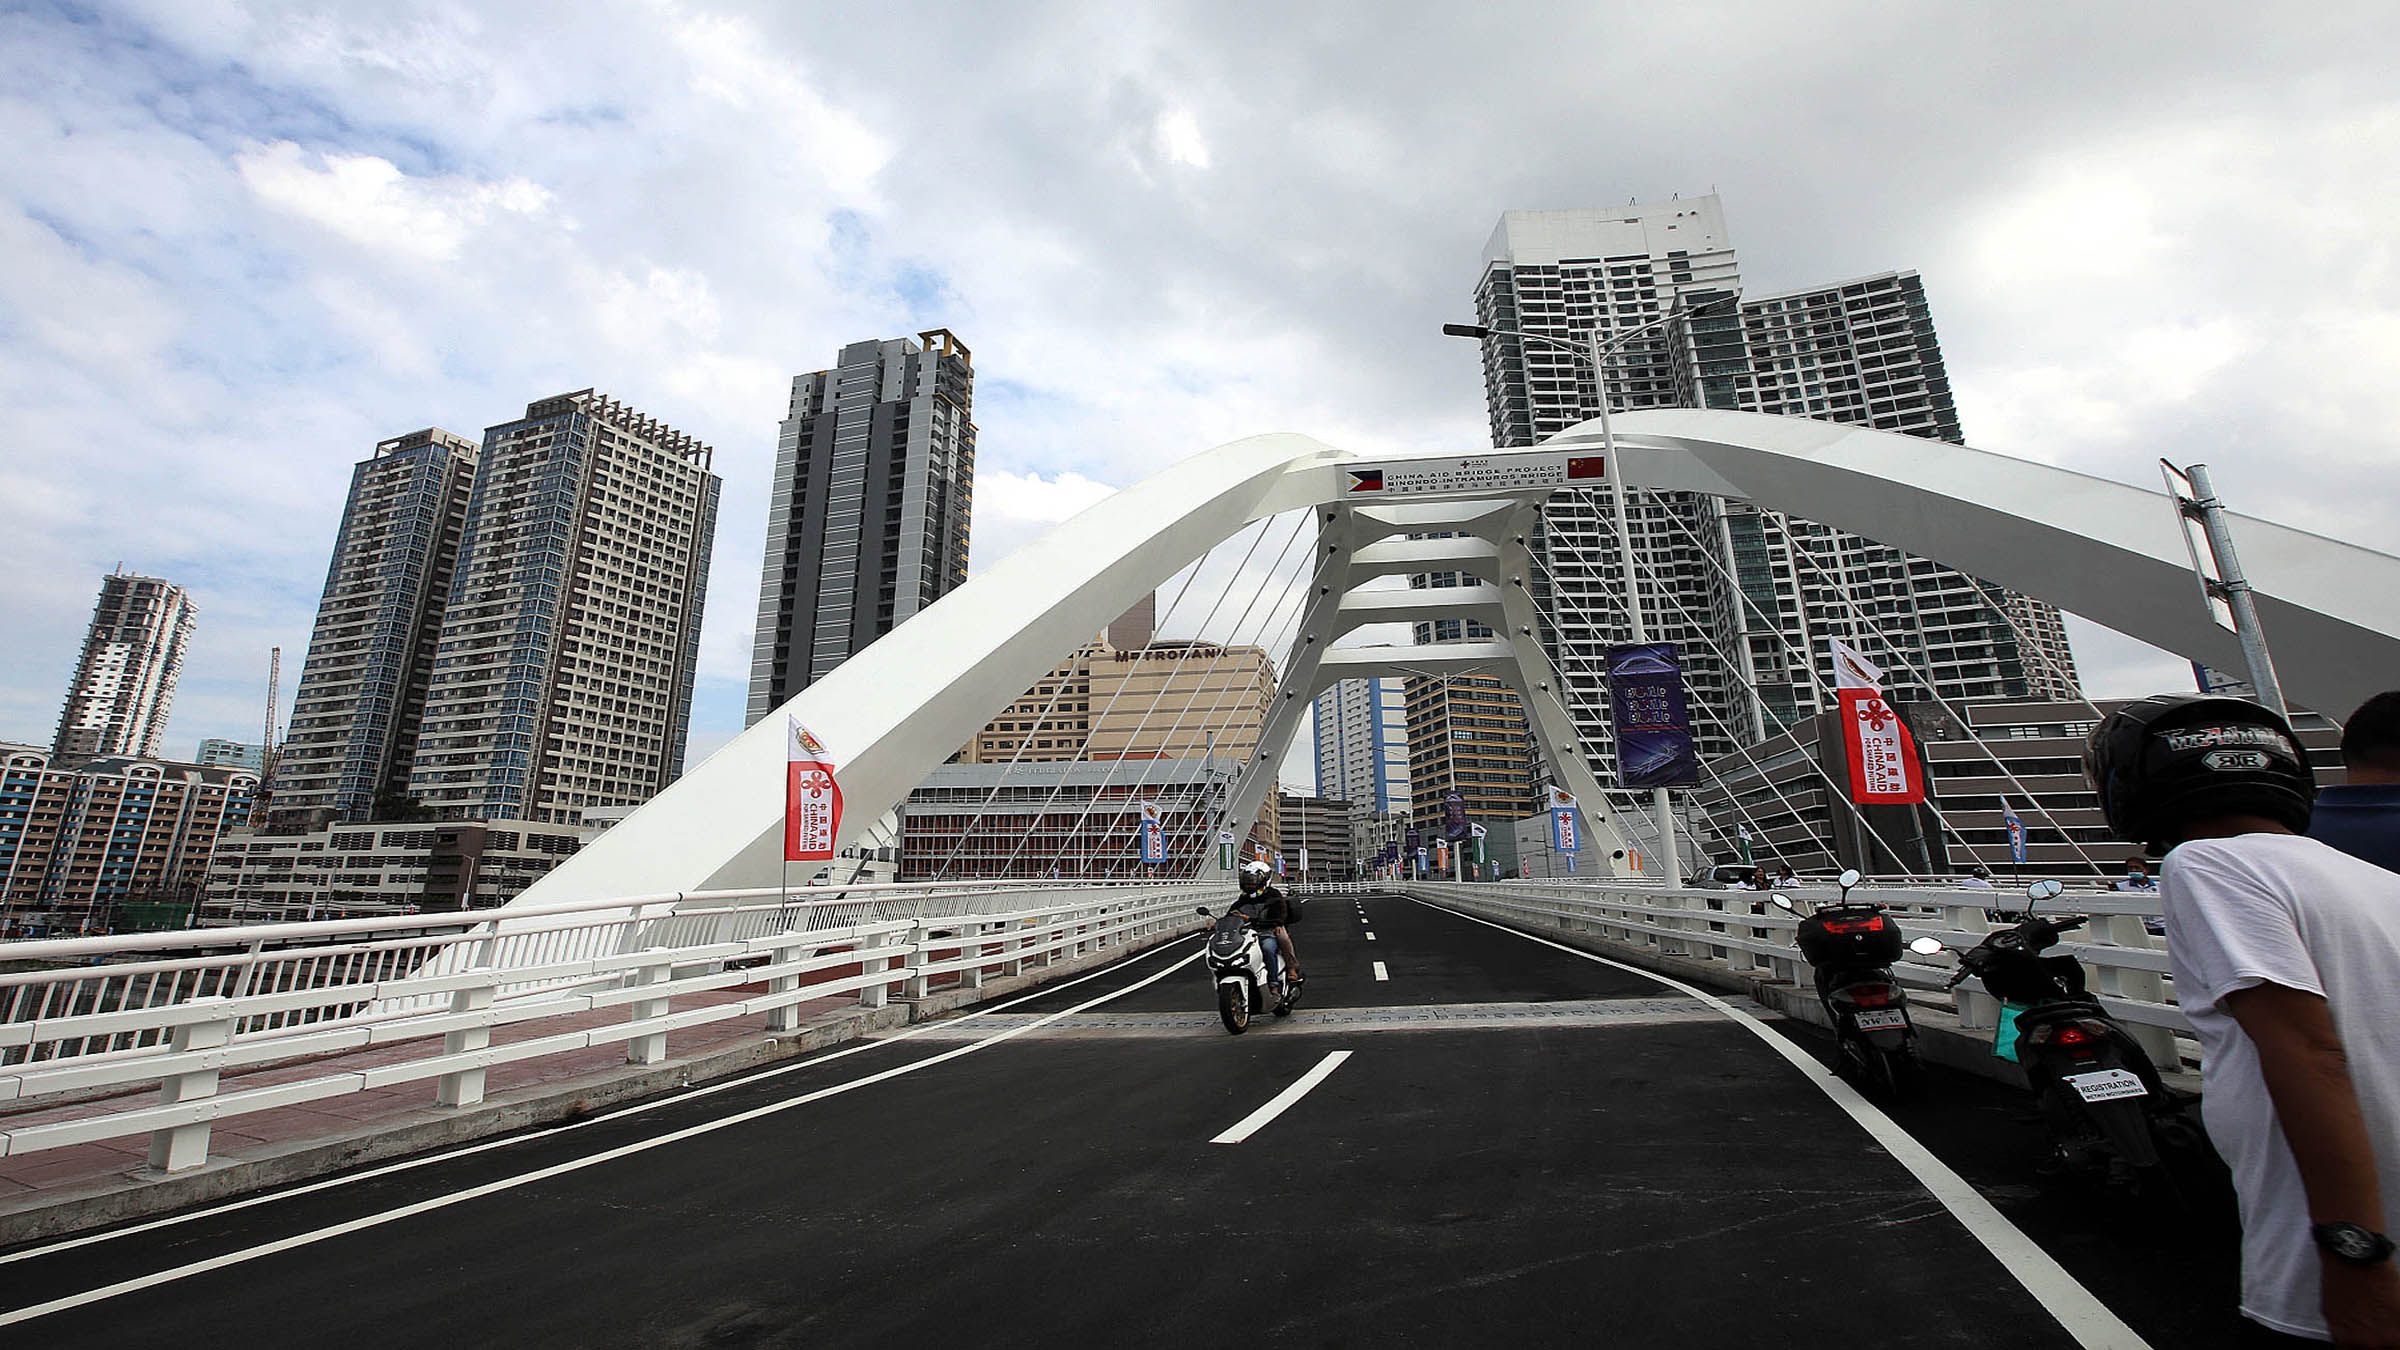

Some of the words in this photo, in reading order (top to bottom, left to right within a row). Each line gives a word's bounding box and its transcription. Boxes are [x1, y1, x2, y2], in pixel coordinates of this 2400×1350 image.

[1387, 473, 1424, 481] CHINA
[1430, 470, 1450, 478] AID
[1455, 468, 1501, 476] BRIDGE
[1507, 465, 1562, 473] PROJECT
[1520, 471, 1562, 479] BRIDGE
[1115, 647, 1228, 663] METROBANK
[1872, 737, 1886, 771] CHINA
[1876, 772, 1887, 792] AID
[809, 803, 818, 832] CHINA
[808, 833, 818, 850] AID
[2080, 1080, 2136, 1093] REGISTRATION
